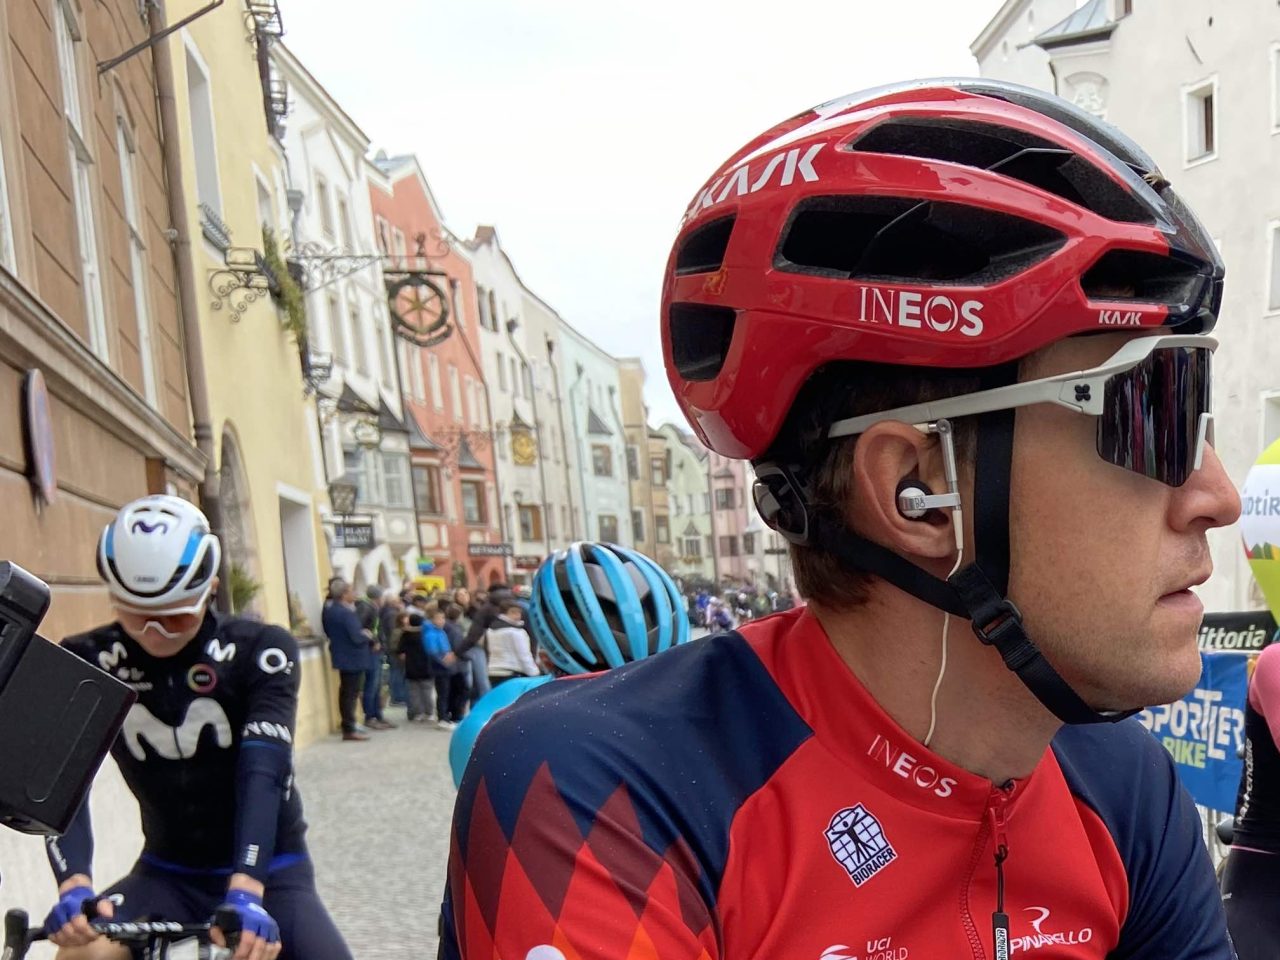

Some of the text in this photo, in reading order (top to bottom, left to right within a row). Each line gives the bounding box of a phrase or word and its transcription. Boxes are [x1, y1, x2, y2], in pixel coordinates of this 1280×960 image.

[690, 143, 827, 214] KASK
[859, 286, 984, 337] INEOS
[1099, 309, 1141, 326] KASK
[1199, 625, 1267, 649] ittoria
[867, 734, 957, 799] INEOS
[1162, 736, 1207, 769] BIKE
[852, 849, 897, 887] BIORACER
[867, 937, 891, 953] UCI
[1009, 927, 1092, 955] PINARELLO
